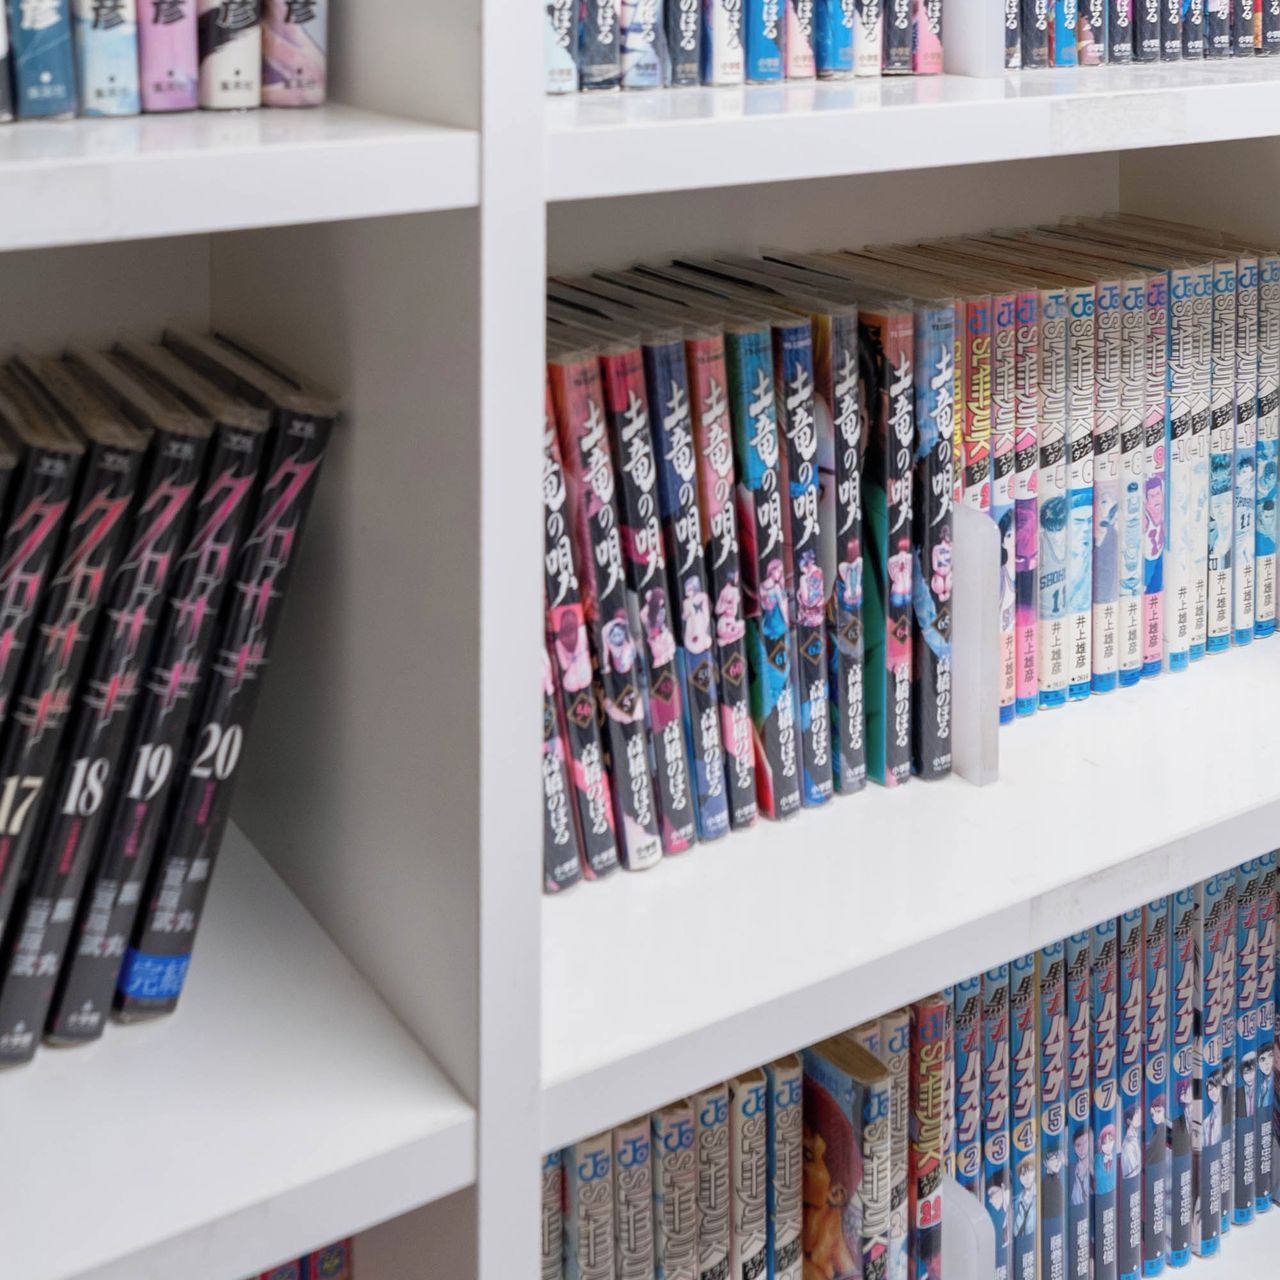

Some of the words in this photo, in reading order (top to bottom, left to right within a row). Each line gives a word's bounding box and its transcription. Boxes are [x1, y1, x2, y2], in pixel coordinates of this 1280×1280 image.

[1075, 615, 1086, 669] 井上雄彦
[191, 723, 242, 781] 20
[132, 743, 173, 802] 19
[65, 759, 110, 817] 18
[1127, 1068, 1139, 1092] 8
[1153, 1055, 1165, 1081] 9
[1075, 1092, 1088, 1118] 6
[1101, 1081, 1114, 1108] 7
[1047, 1105, 1062, 1131] 5
[1018, 1123, 1033, 1147] 4
[964, 1146, 980, 1169] 2
[992, 1136, 1007, 1161] 3
